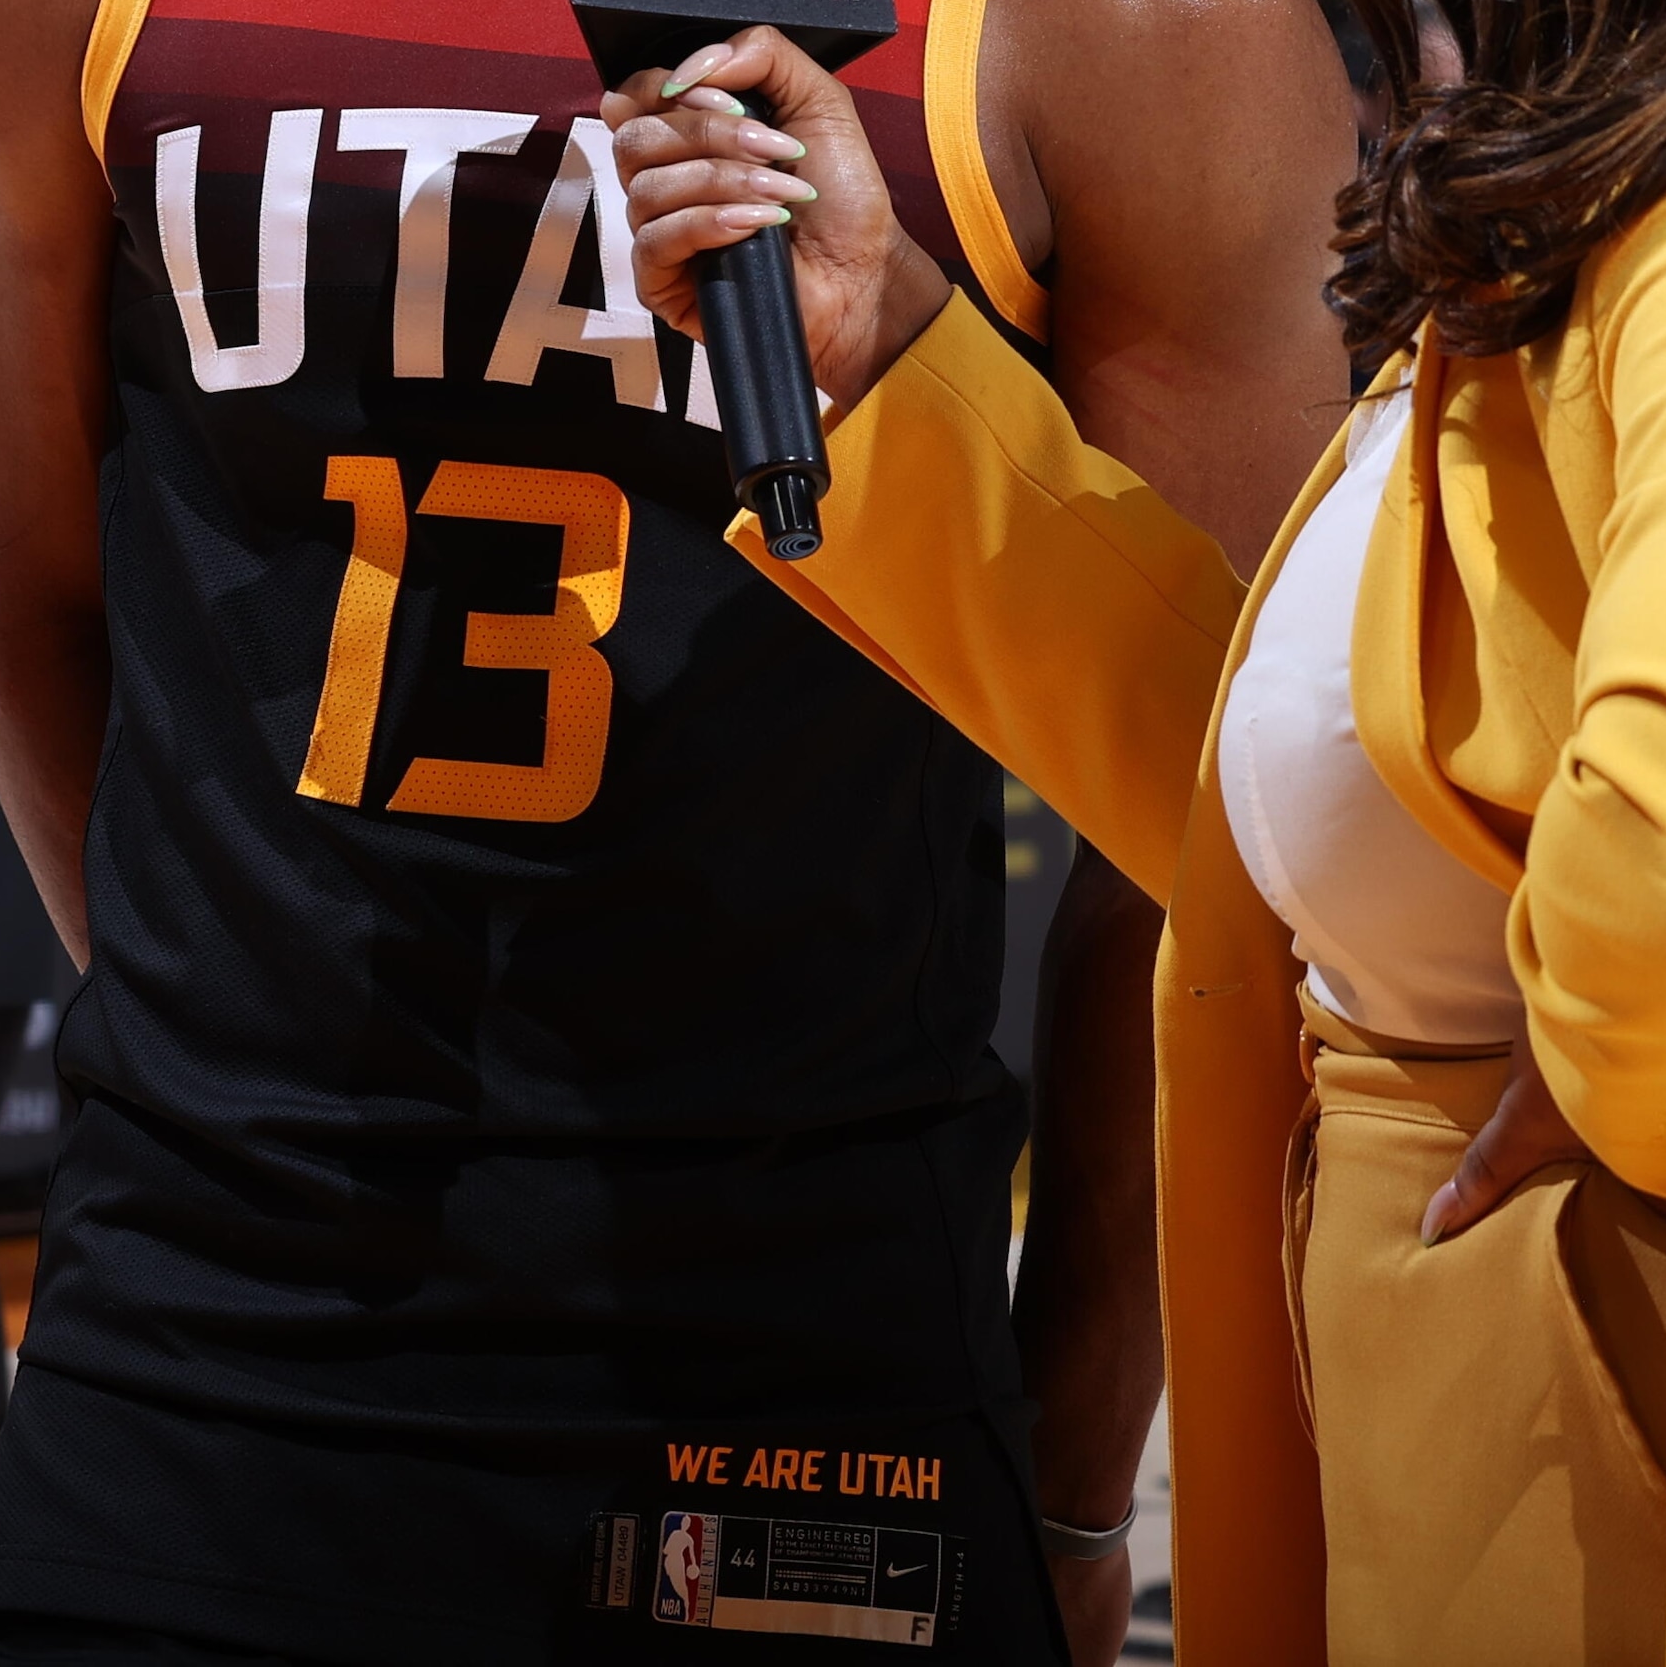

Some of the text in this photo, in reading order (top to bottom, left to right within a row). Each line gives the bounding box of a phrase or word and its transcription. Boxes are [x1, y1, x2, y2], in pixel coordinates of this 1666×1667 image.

[295, 455, 631, 823] 13
[667, 1443, 941, 1501] WE ARE UTAH
[775, 1528, 871, 1545] ENGINEERED
[696, 1516, 717, 1624] AUTHENTICS
[730, 1548, 756, 1568] 44
[661, 1599, 681, 1616] NBA
[949, 1573, 965, 1631] LENGTH
[910, 1616, 930, 1642] F
